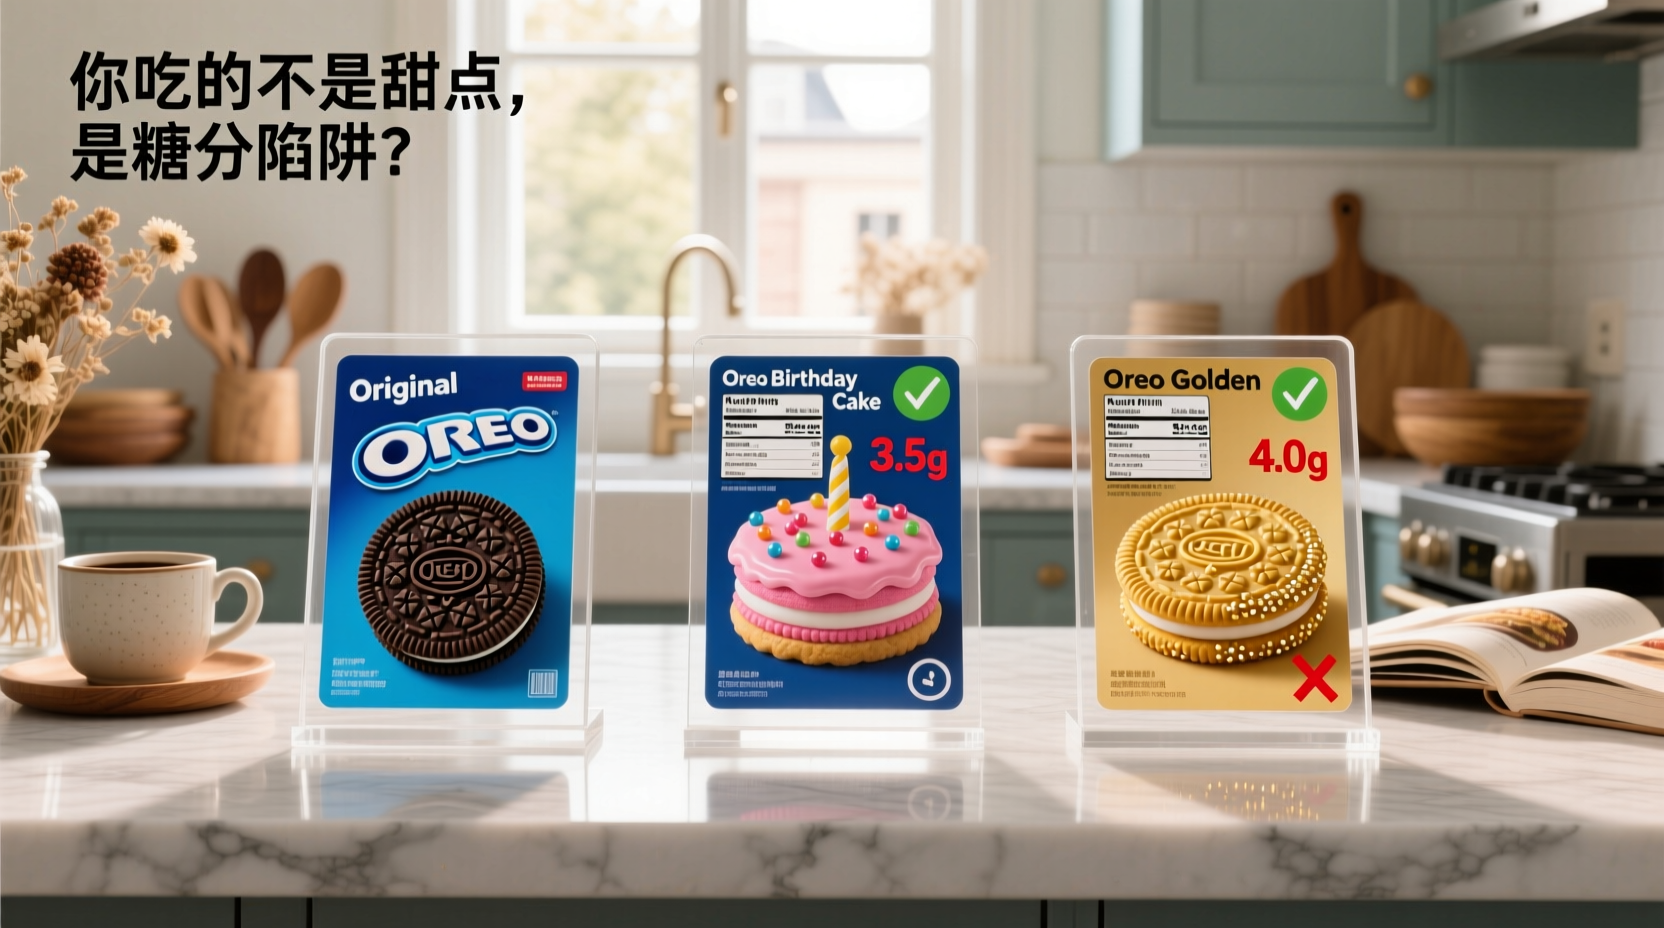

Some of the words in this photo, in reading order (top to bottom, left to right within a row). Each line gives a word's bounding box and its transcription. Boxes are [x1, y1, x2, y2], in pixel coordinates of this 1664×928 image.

[349, 371, 458, 405] Original
[722, 369, 768, 387] Oreo
[771, 368, 858, 391] Birthday
[1103, 368, 1165, 390] Oreo
[1170, 369, 1261, 391] Golden
[832, 390, 882, 411] Cake
[362, 412, 550, 478] OREO
[870, 437, 948, 481] 3.5g
[1248, 438, 1329, 482] 4.0g
